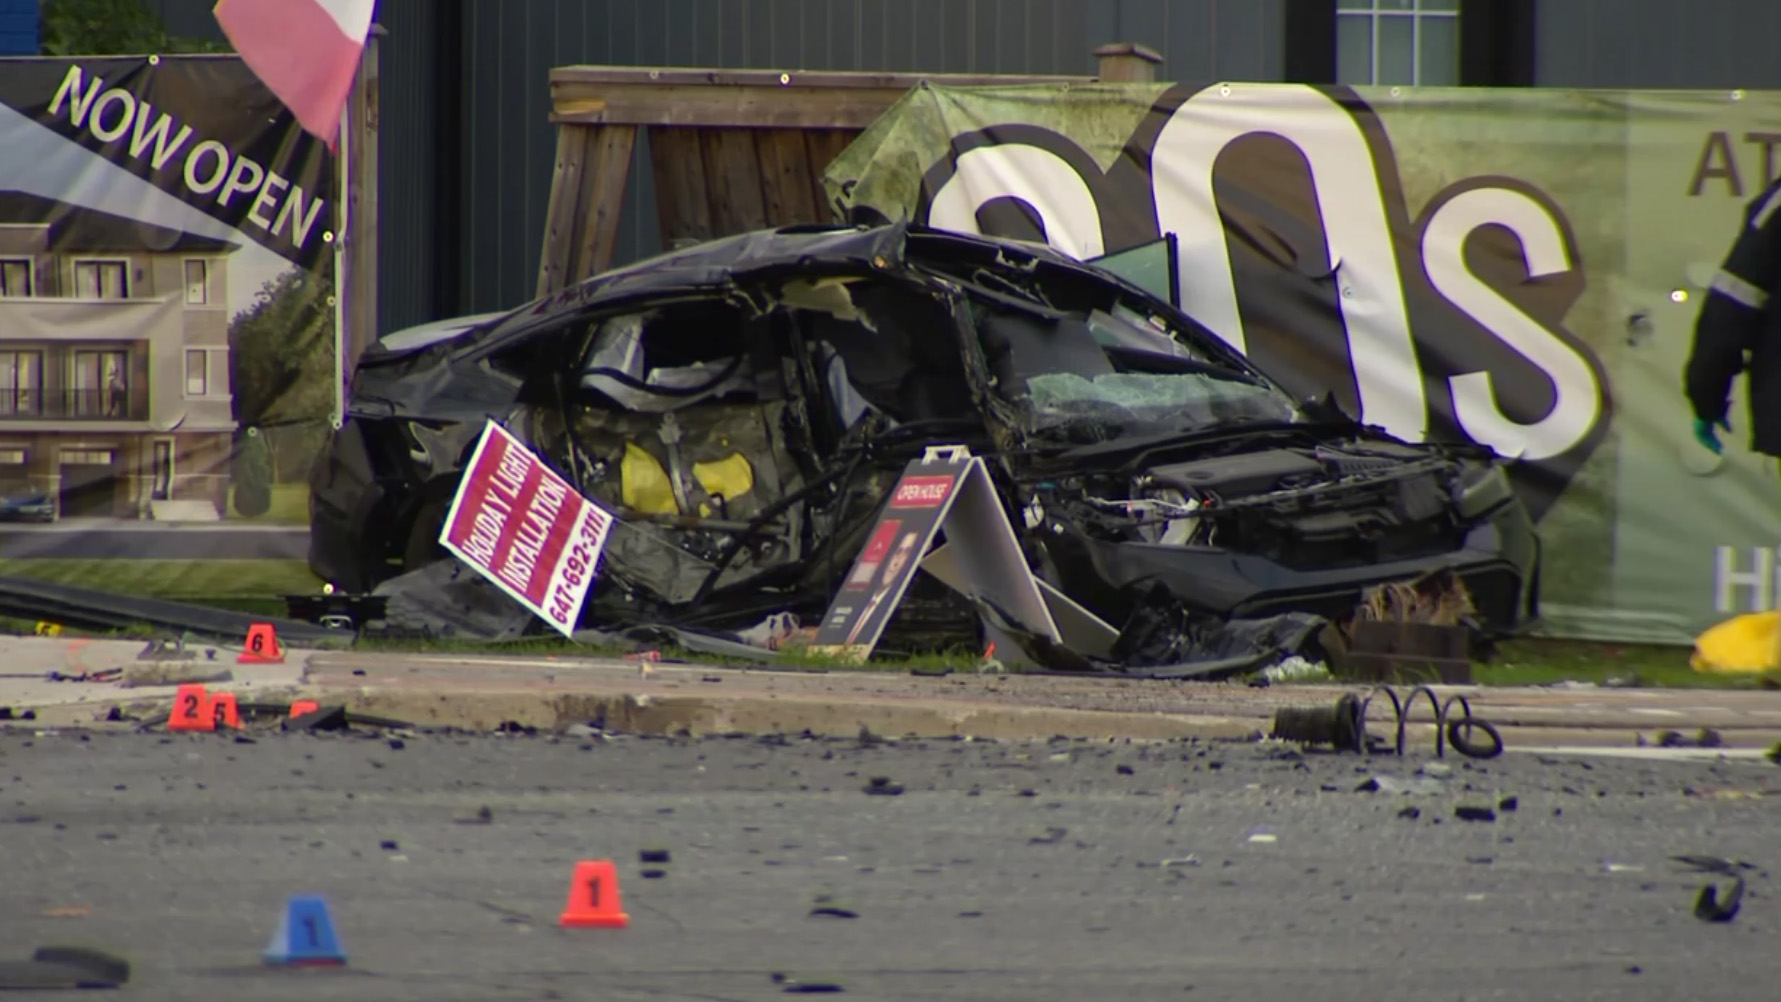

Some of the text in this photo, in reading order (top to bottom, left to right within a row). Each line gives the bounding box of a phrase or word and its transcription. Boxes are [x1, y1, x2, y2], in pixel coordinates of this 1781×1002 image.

[48, 65, 324, 248] NOW OPEN
[462, 444, 534, 568] HOLIDAY LIGHT
[498, 473, 567, 593] INSTALLATION
[251, 633, 263, 653] 6
[184, 695, 198, 718] 2
[588, 876, 600, 907] 1
[303, 917, 318, 947] 1
